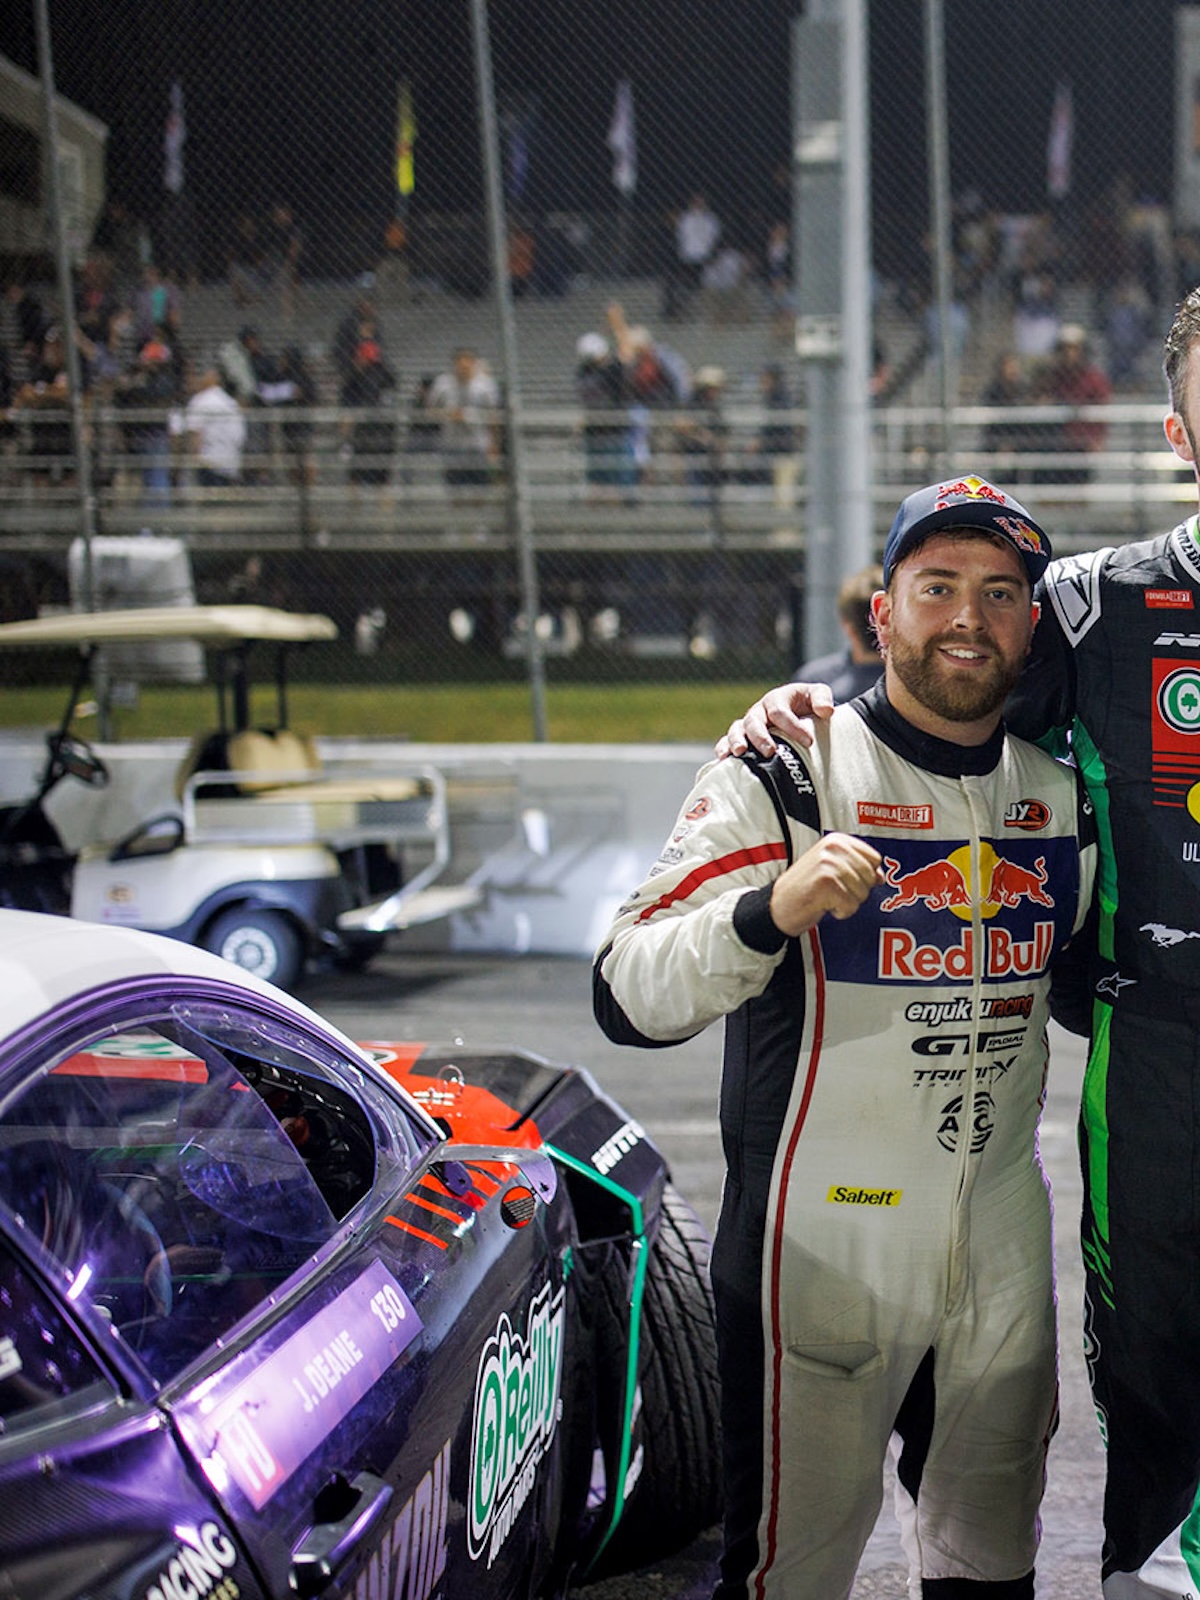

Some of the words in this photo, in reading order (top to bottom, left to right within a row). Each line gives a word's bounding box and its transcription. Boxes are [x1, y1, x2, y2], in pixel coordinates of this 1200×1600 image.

[859, 804, 898, 820] FORMULA
[897, 807, 930, 823] DRIFT
[881, 929, 976, 978] Red
[988, 923, 1053, 975] Bull
[911, 1030, 990, 1056] GT
[833, 1187, 897, 1206] Sabelt
[303, 1330, 364, 1399] DEANE
[369, 1283, 406, 1334] 130
[474, 1315, 561, 1526] O'Reilly
[145, 1521, 238, 1600] ACING
